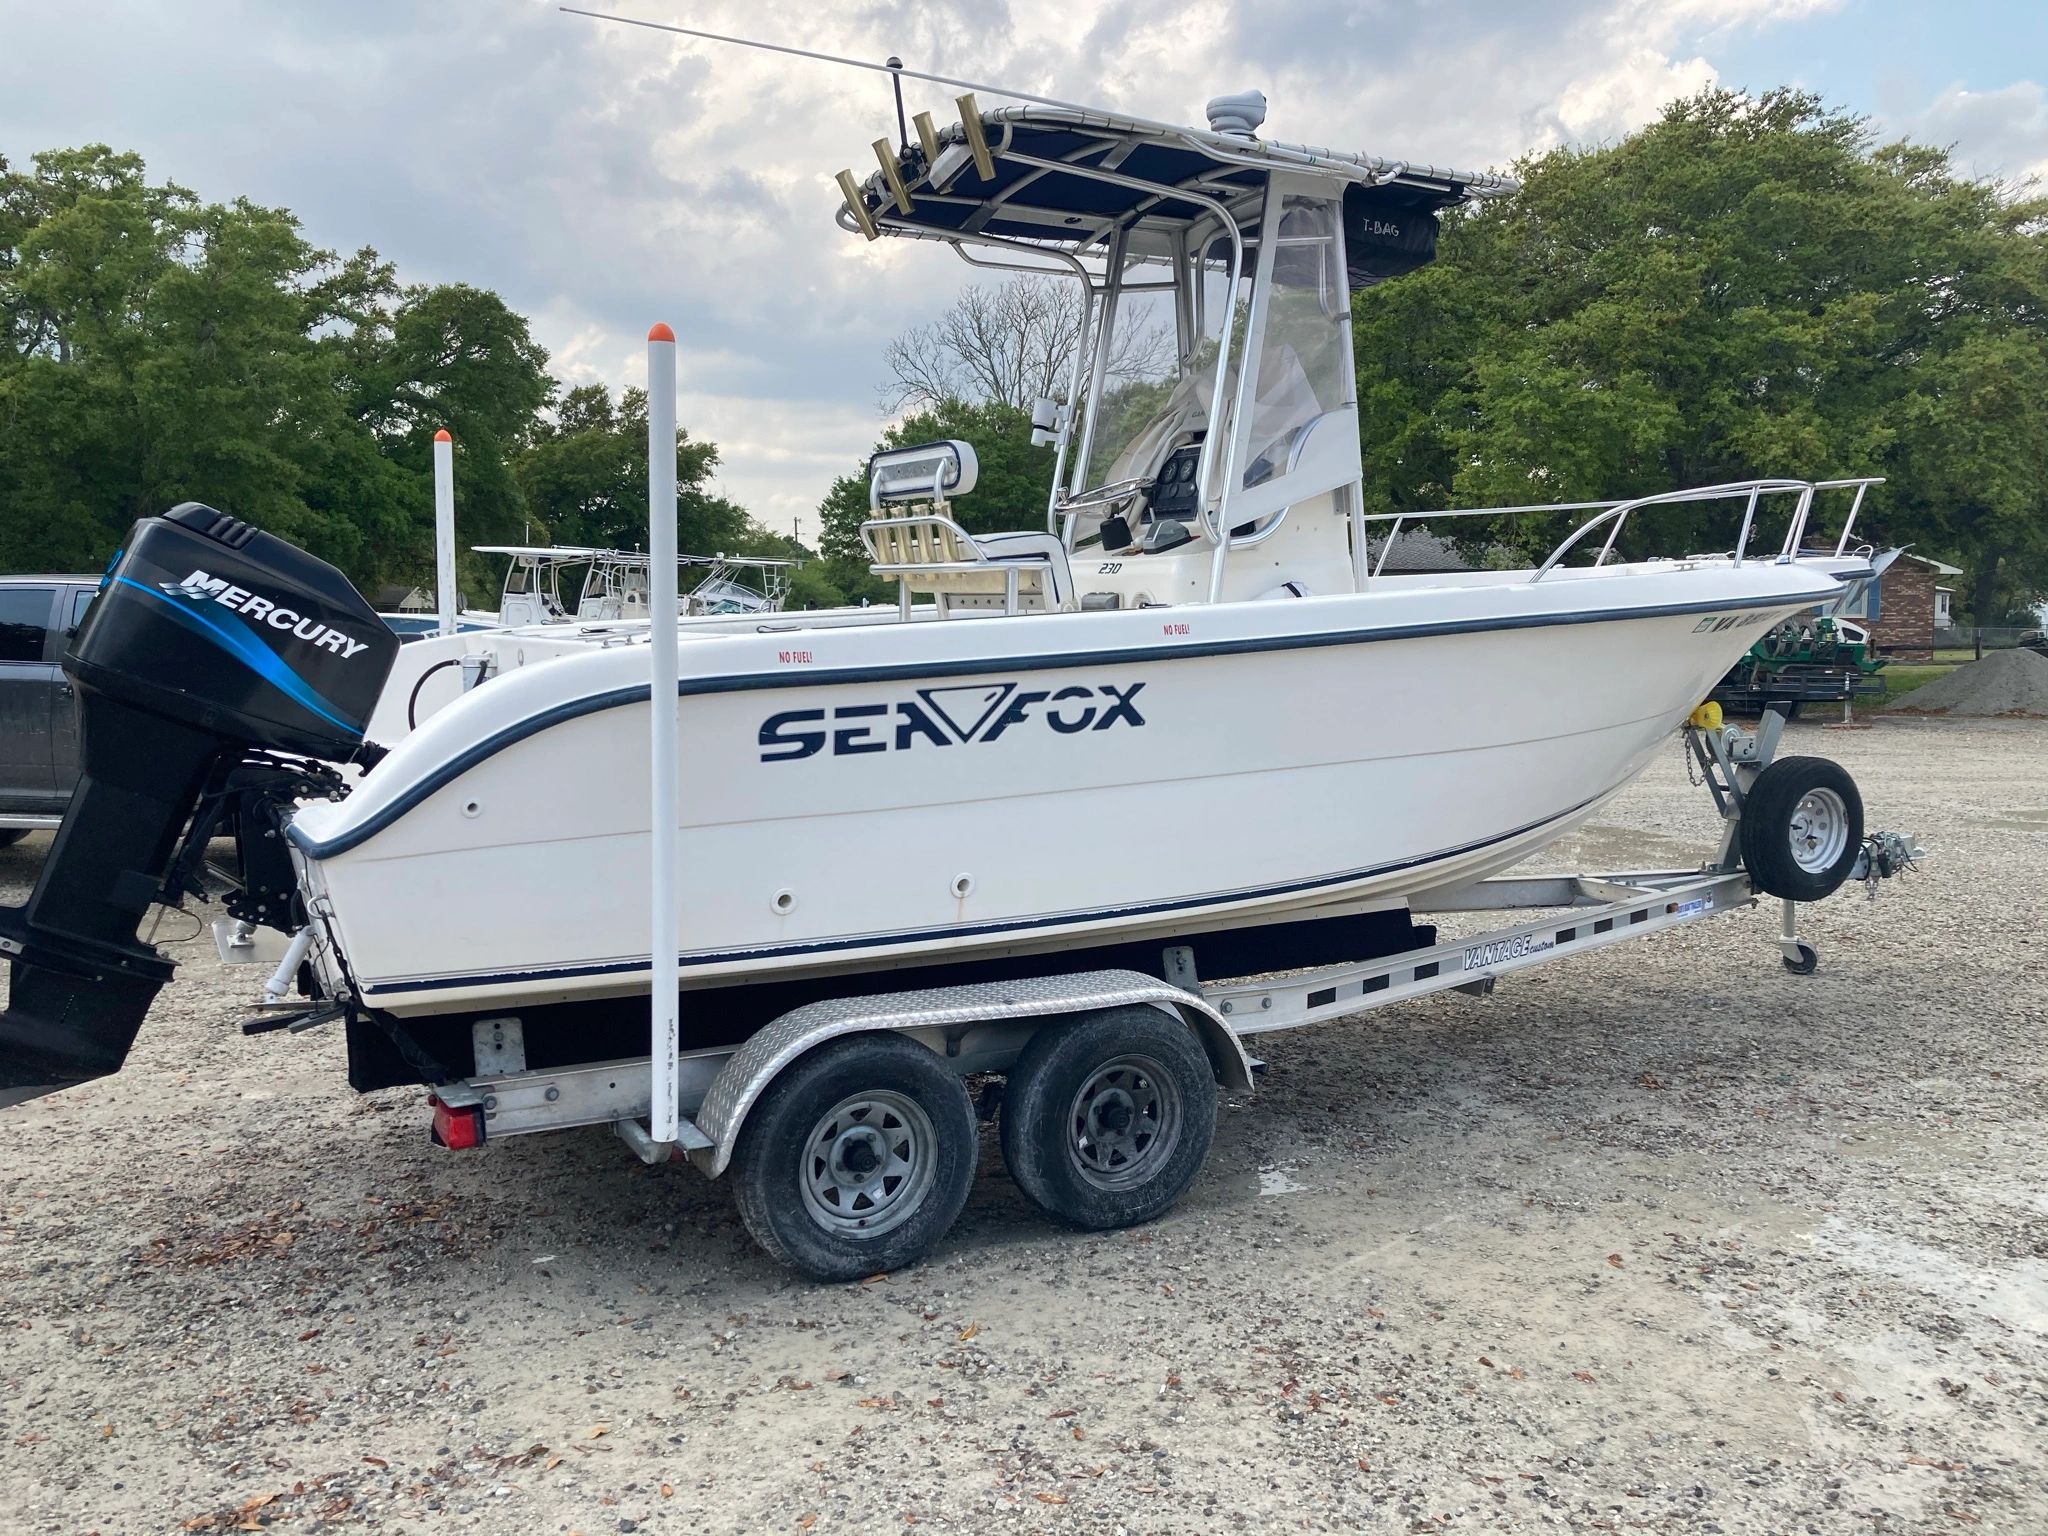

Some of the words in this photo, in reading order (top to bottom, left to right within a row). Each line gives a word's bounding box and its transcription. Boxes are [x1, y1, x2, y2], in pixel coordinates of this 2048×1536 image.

[1363, 217, 1399, 236] T-BAG
[1098, 563, 1122, 574] 230
[179, 570, 369, 659] MERCURY
[1163, 624, 1173, 636] NO
[1174, 623, 1190, 635] FUEL!
[779, 651, 790, 663] NO
[793, 651, 813, 663] FUEL!
[1464, 934, 1532, 970] VANTAGE
